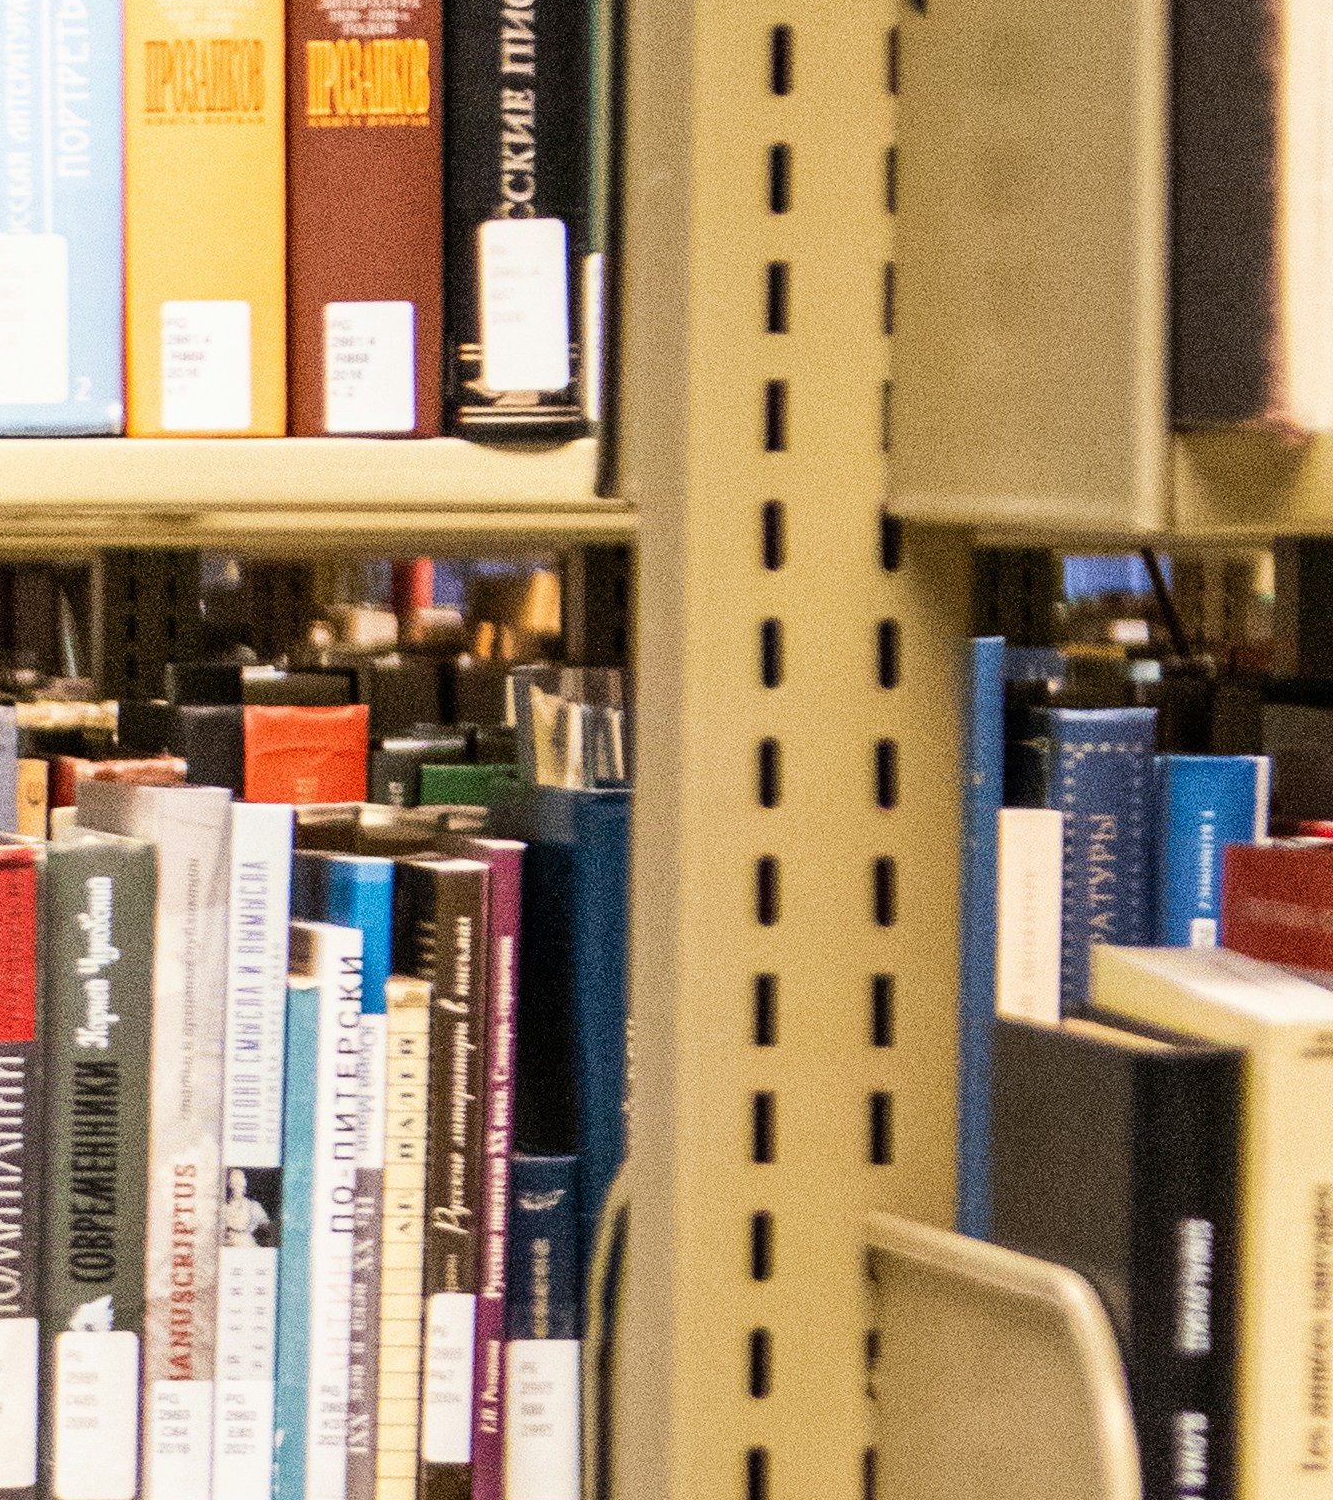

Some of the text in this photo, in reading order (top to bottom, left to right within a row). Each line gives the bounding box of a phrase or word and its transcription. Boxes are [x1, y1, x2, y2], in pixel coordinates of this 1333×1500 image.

[144, 39, 265, 114] ПРОЗАИКОВ
[306, 39, 431, 115] ПРОЗАИКОВ
[236, 858, 270, 954] ВЫМЫСЛА
[231, 984, 263, 1065] СМЫСЛА
[326, 954, 364, 1234] ПО-ПИТЕРСКИ
[68, 1061, 121, 1285] СОВРЕМЕННИКИ
